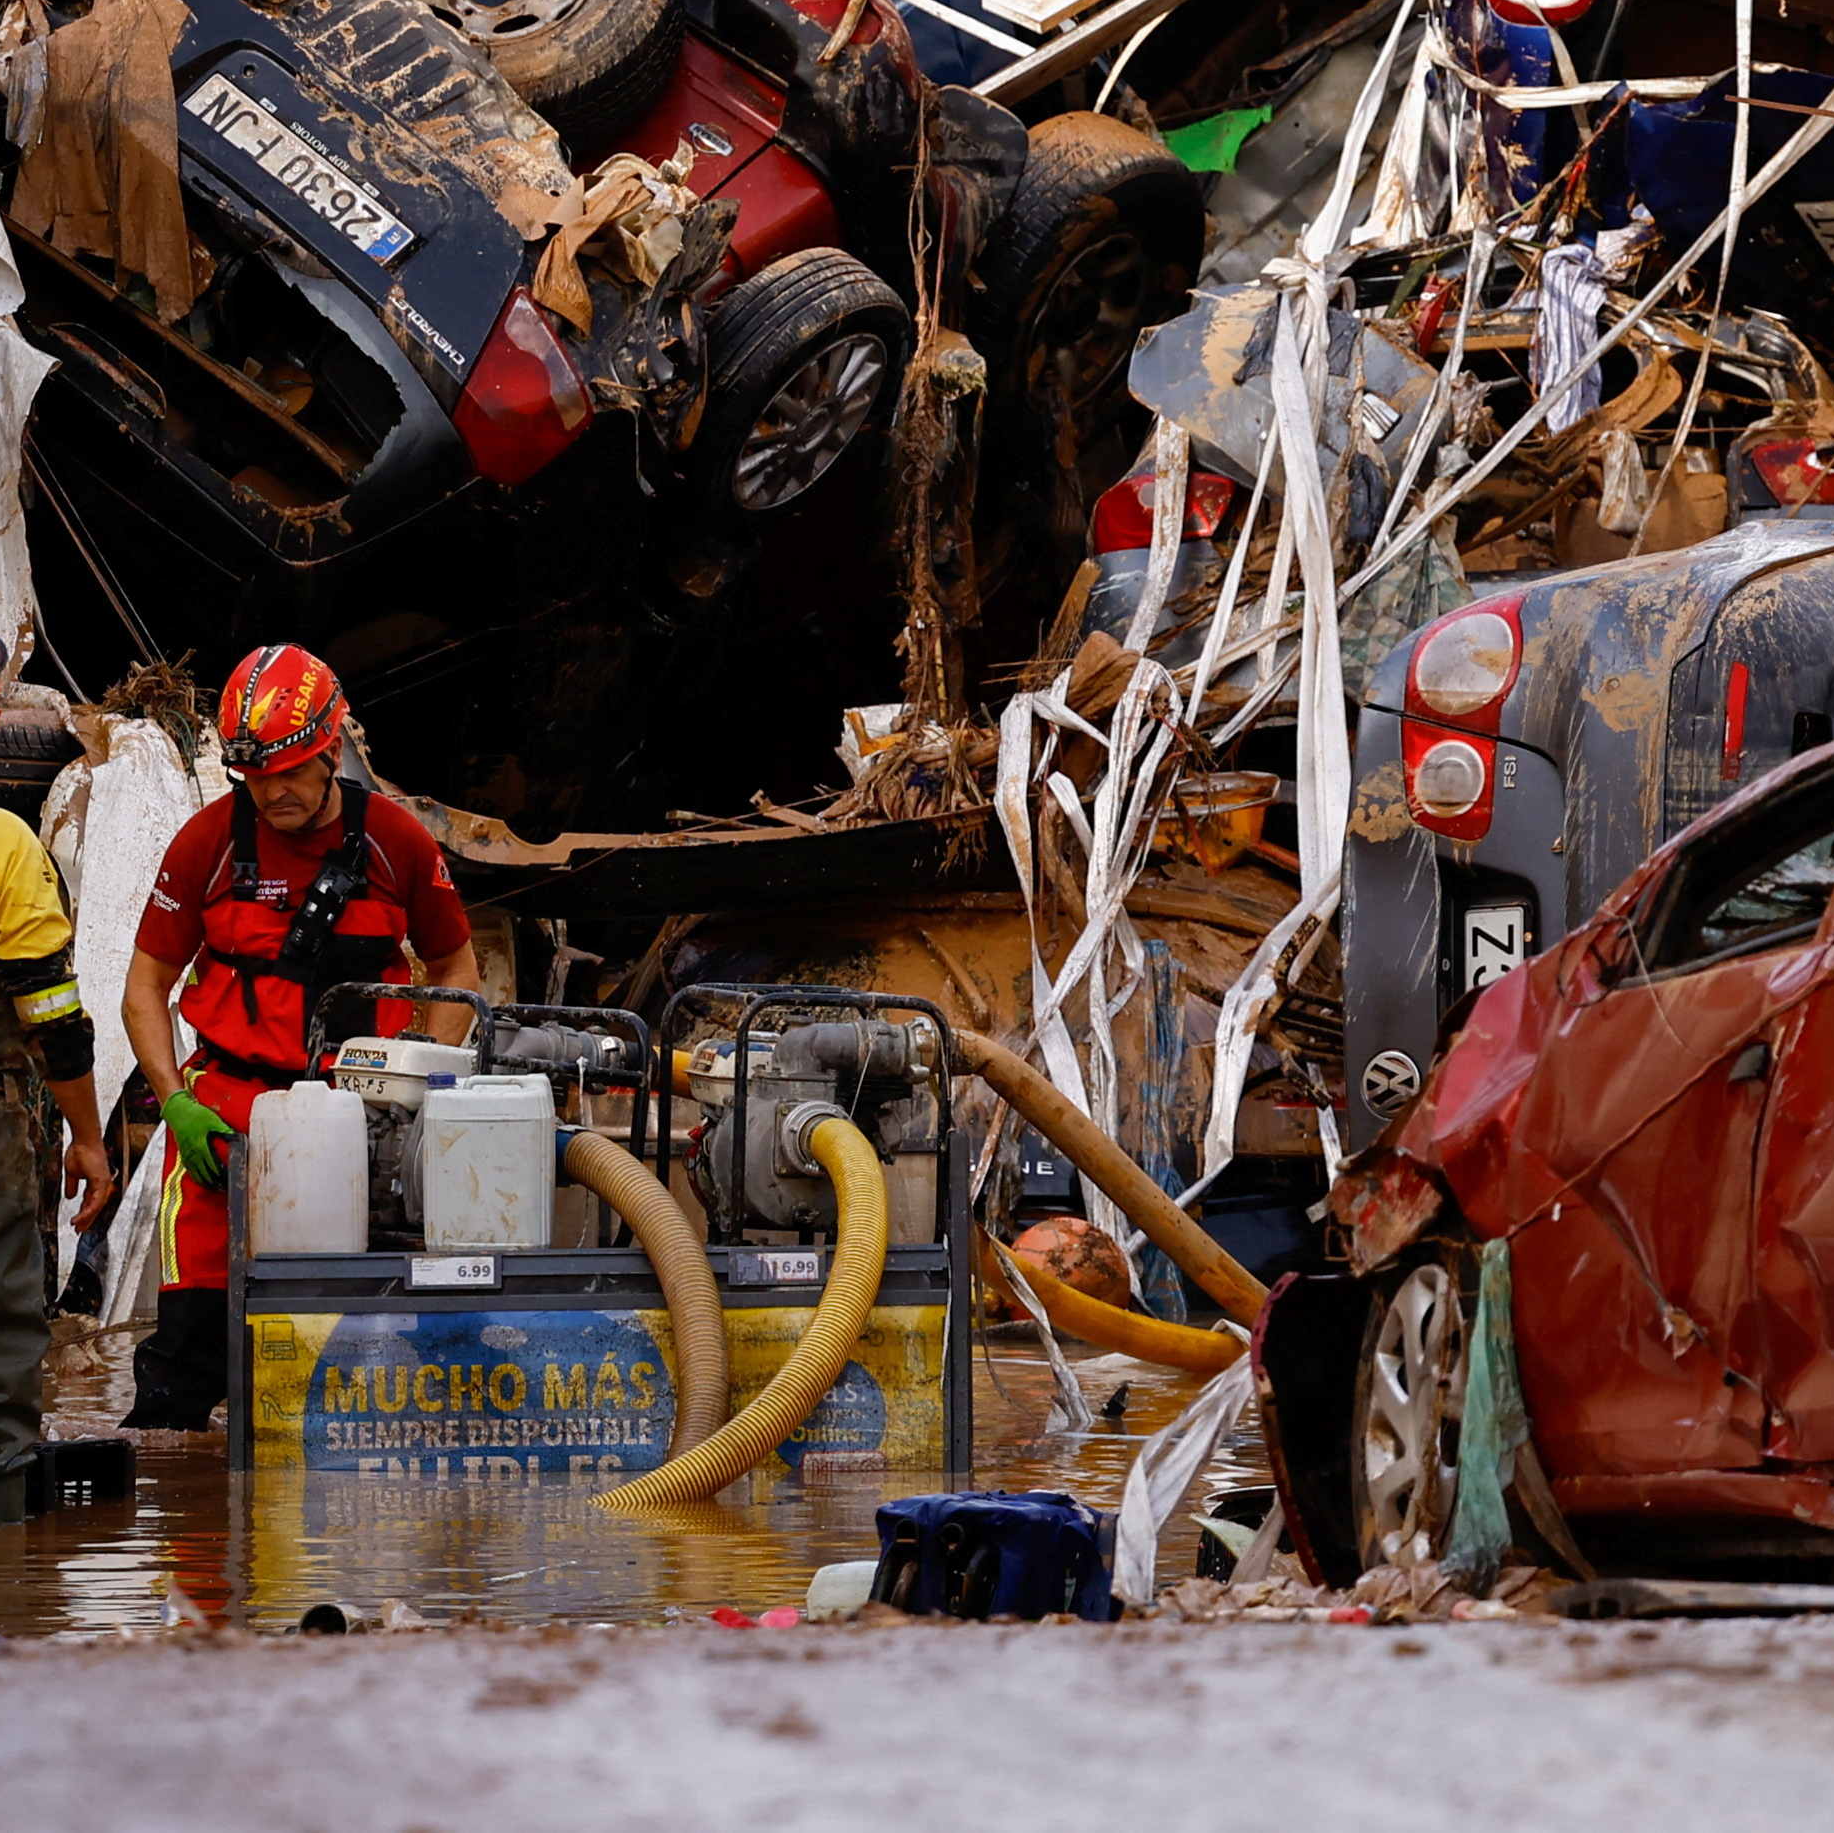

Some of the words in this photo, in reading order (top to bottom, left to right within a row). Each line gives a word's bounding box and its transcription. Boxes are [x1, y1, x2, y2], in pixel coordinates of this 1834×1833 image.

[203, 90, 288, 165] FJN
[288, 119, 330, 155] MOTORS
[328, 151, 350, 172] RDP
[281, 157, 388, 243] 2630
[1502, 754, 1517, 789] FSI
[343, 1047, 388, 1061] HONDA
[457, 1264, 492, 1278] 6.99
[781, 1260, 816, 1274] 6.99
[323, 1362, 528, 1414] MUCHO
[542, 1351, 657, 1411] MÁS
[325, 1418, 461, 1451] SIEMPRE
[467, 1416, 656, 1449] DISPONIBLE
